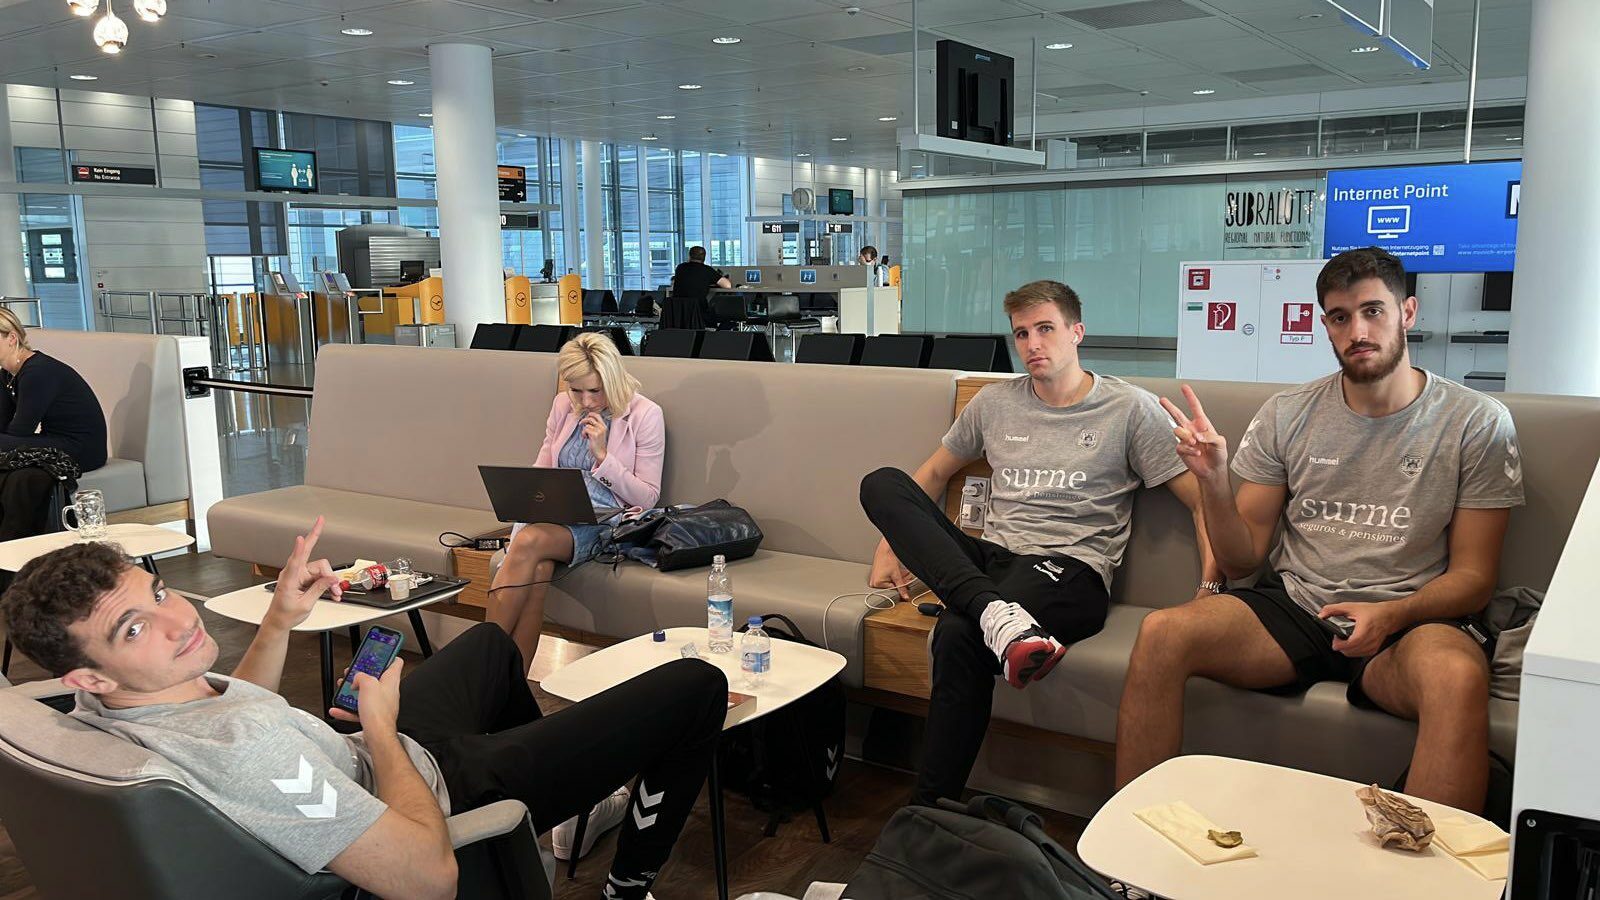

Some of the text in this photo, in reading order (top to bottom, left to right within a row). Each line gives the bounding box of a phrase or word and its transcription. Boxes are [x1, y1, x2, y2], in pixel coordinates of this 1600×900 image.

[1334, 183, 1449, 201] Internet Point
[1004, 434, 1030, 442] hummel
[1309, 456, 1339, 466] hummel
[1001, 467, 1087, 490] surne
[1301, 498, 1411, 529] surne
[1299, 522, 1337, 534] seguros
[1348, 530, 1407, 545] pensiones
